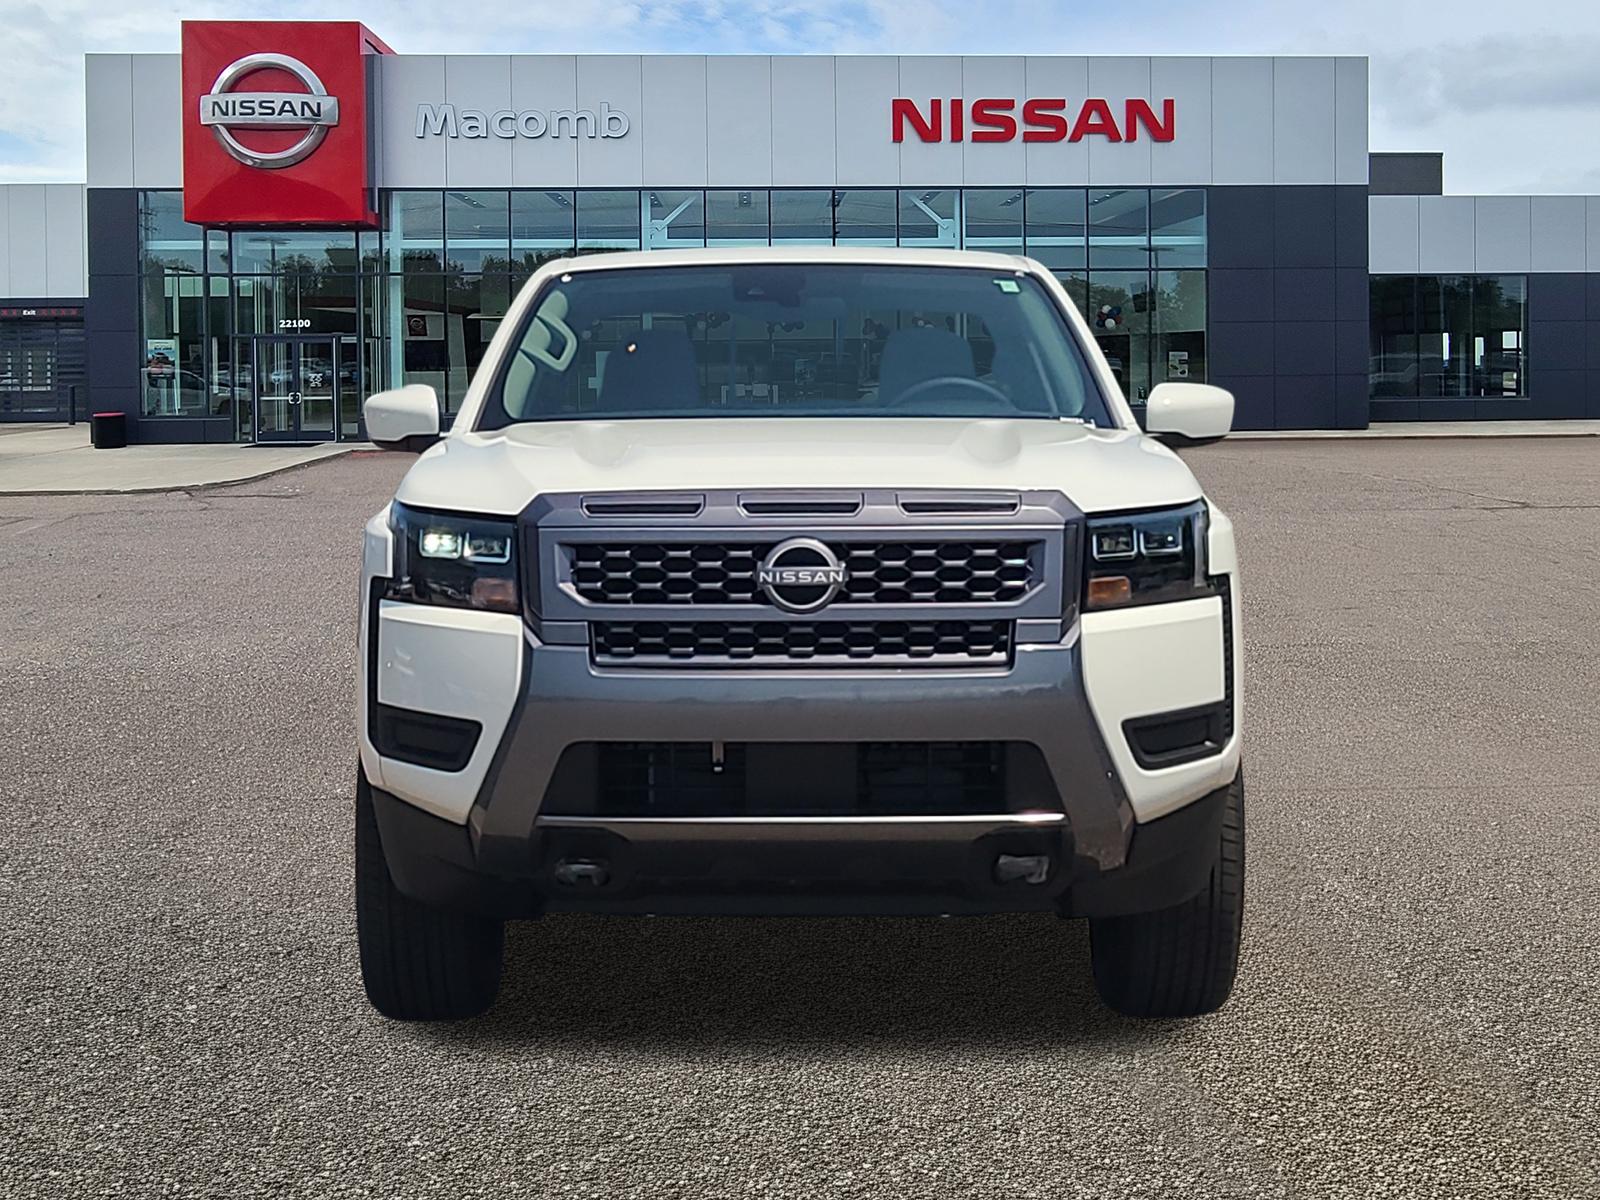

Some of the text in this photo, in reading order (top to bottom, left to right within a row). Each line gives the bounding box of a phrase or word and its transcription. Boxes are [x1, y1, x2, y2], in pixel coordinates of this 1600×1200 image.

[212, 100, 322, 118] NISSAN
[415, 102, 630, 139] Macomb
[892, 98, 1176, 143] NISSAN
[279, 319, 311, 328] 22100
[759, 571, 844, 583] NISSAN
